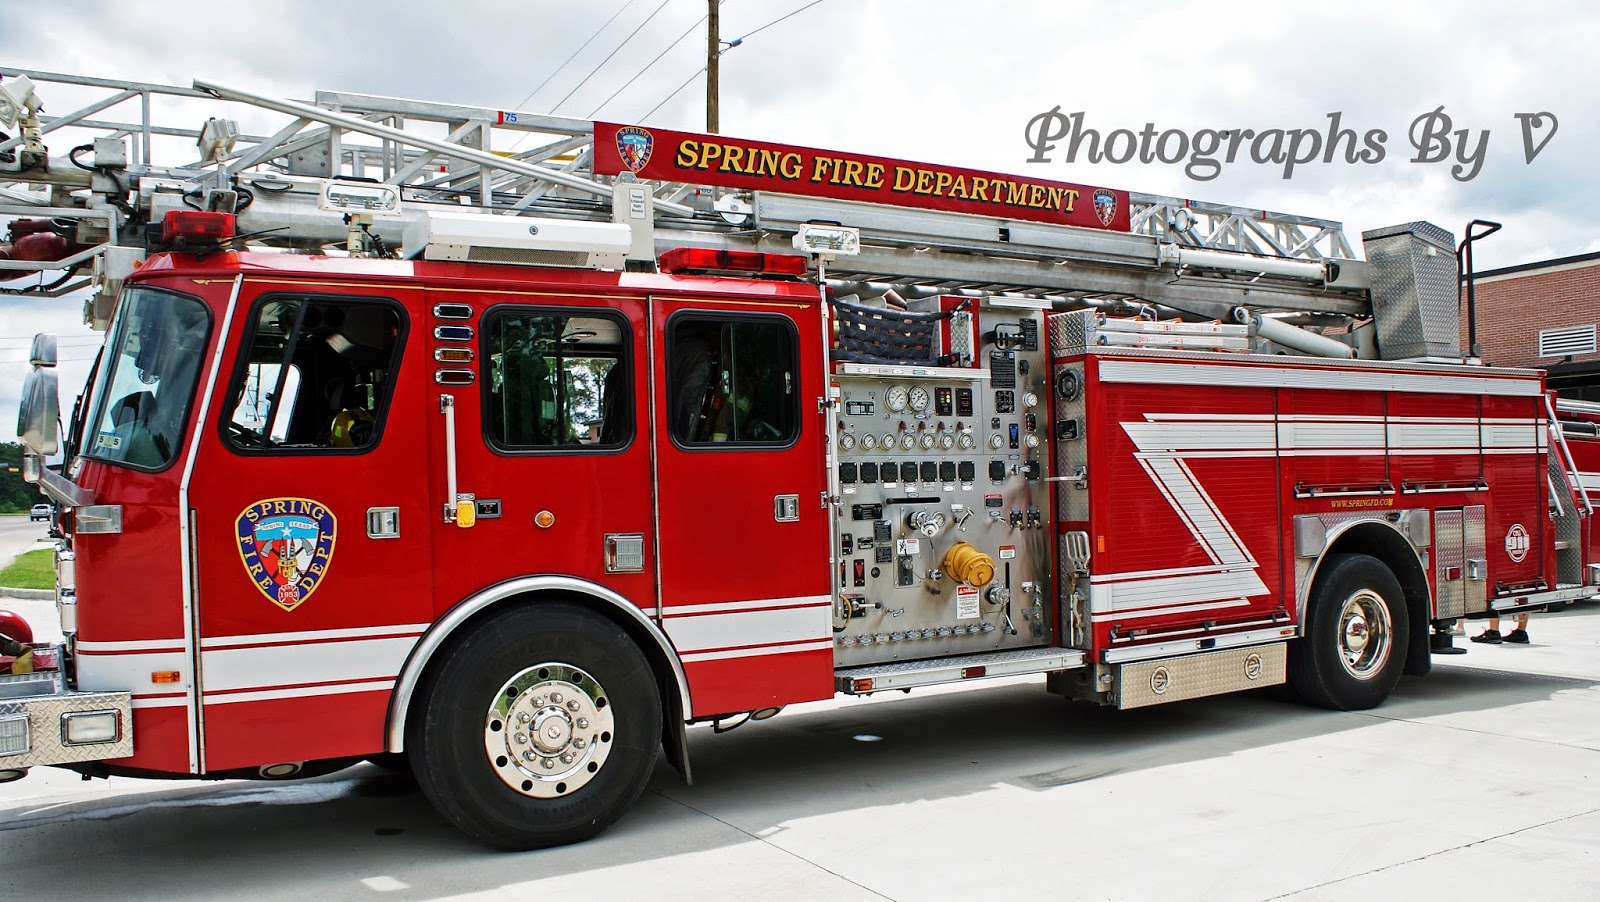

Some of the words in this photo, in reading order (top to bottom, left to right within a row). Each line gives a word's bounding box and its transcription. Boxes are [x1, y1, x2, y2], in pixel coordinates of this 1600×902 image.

[505, 113, 517, 122] 75
[619, 127, 650, 138] SPRING
[617, 140, 630, 164] FIRE
[640, 142, 652, 167] DEPT
[676, 140, 803, 180] SPRING
[812, 156, 885, 188] FIRE
[893, 166, 1079, 213] DEPARTMENT
[245, 500, 325, 523] SPRING
[261, 522, 283, 530] SPRING
[240, 534, 273, 590] FIRE
[299, 531, 333, 592] DEPT
[280, 591, 298, 599] 1953
